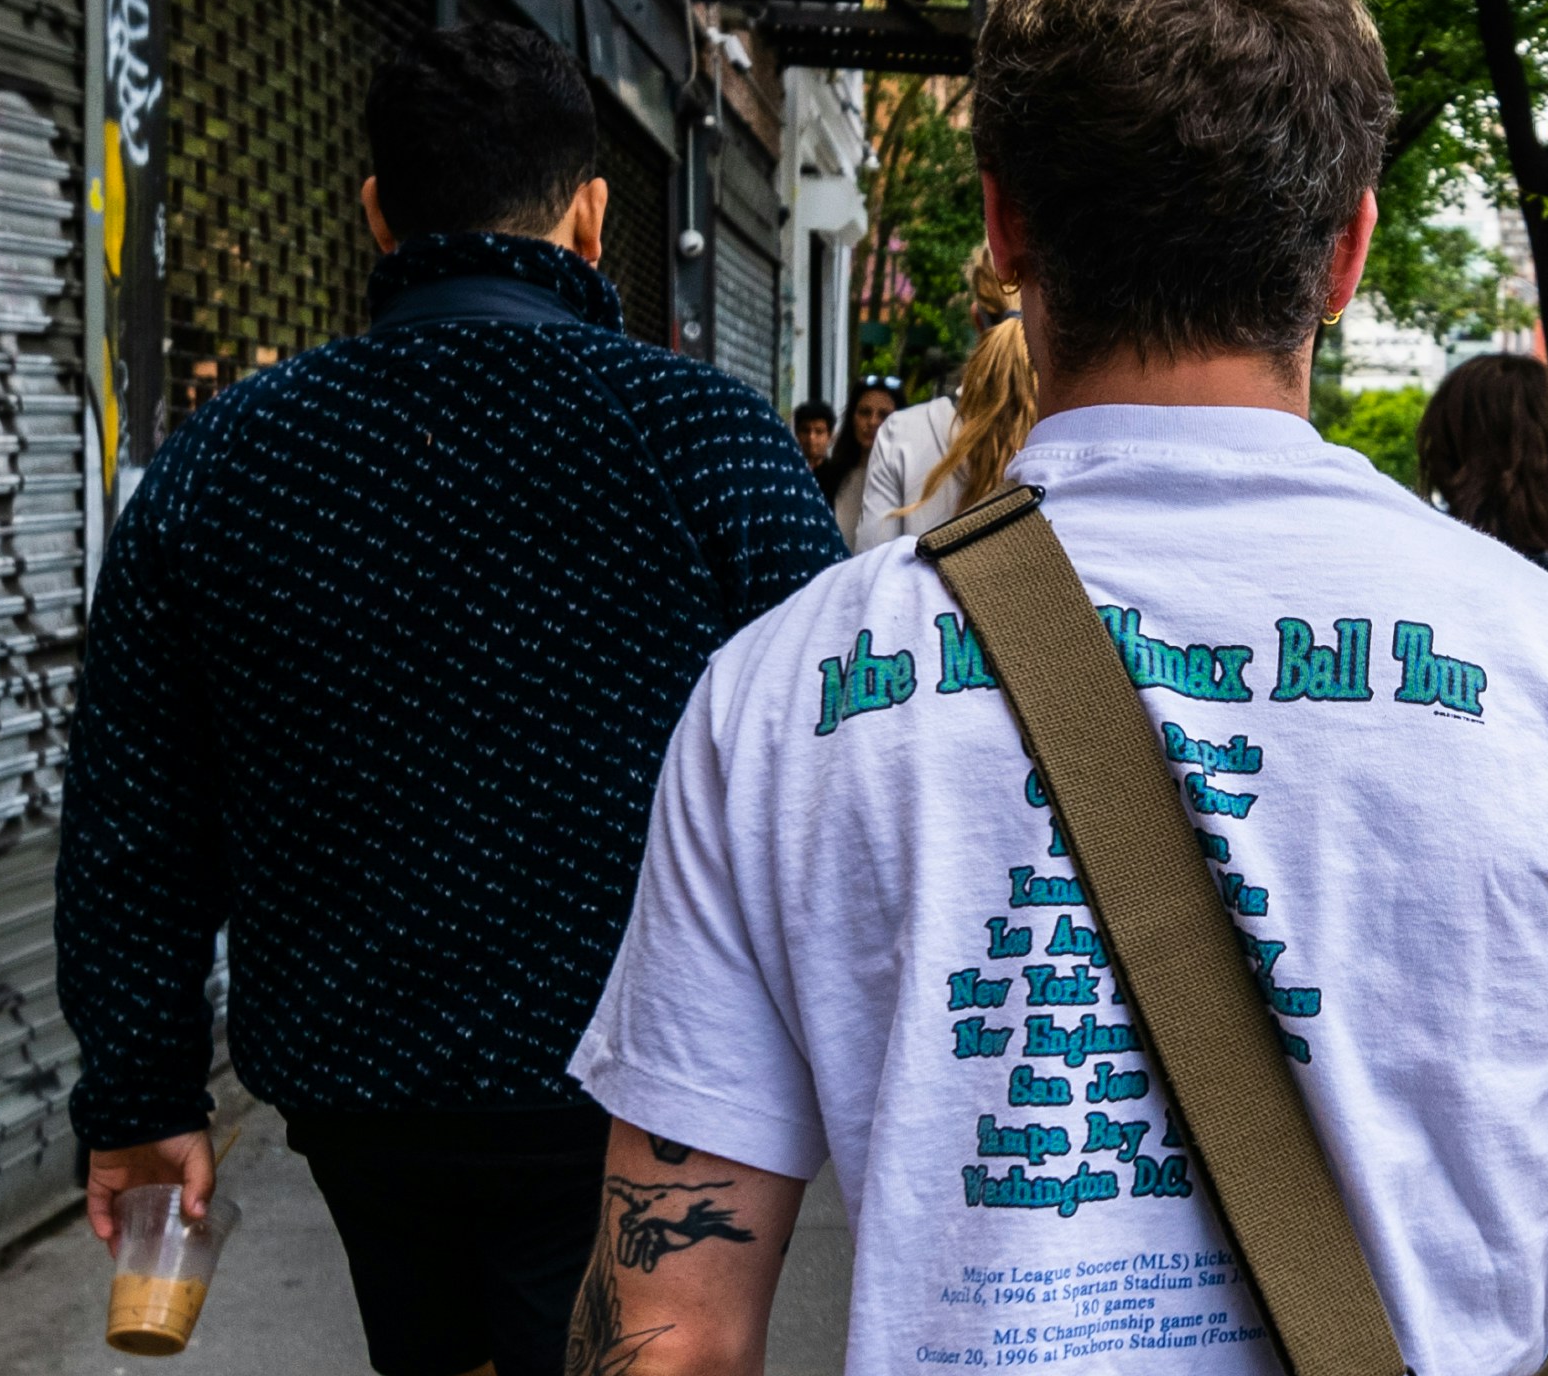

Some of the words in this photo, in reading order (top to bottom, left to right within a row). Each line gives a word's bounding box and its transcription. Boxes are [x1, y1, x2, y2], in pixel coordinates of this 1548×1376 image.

[1269, 617, 1374, 703] Ball
[1391, 620, 1487, 717] Tour
[1161, 721, 1263, 777] Rapids
[1184, 772, 1259, 819] Crew
[946, 967, 1014, 1012] New
[1022, 963, 1102, 1006] York
[951, 1016, 1015, 1060] New
[1008, 1064, 1074, 1108] San
[977, 1113, 1072, 1166] Tampa
[1081, 1111, 1151, 1163] Bay
[961, 1161, 1121, 1218] Washington
[1131, 1154, 1194, 1198] D.C.
[962, 1266, 1005, 1286] Major
[1011, 1267, 1072, 1285] League
[1076, 1260, 1129, 1277] Soccer
[1133, 1253, 1190, 1274] (MLS)
[994, 1287, 1037, 1305] 1996
[1042, 1289, 1058, 1303] at
[1062, 1278, 1119, 1302] Spartan
[1123, 1273, 1193, 1292] Stadium
[1198, 1271, 1226, 1287] San
[993, 1327, 1038, 1346] MLS
[1043, 1314, 1155, 1343] Championship
[1160, 1314, 1203, 1333] game
[1208, 1312, 1228, 1325] on
[1075, 1298, 1100, 1318] 180
[1104, 1297, 1156, 1315] games
[964, 1349, 989, 1368] 20,
[996, 1348, 1039, 1367] 1996
[1043, 1348, 1058, 1363] at
[1063, 1337, 1125, 1360] Foxboro
[1129, 1332, 1198, 1350] Stadium
